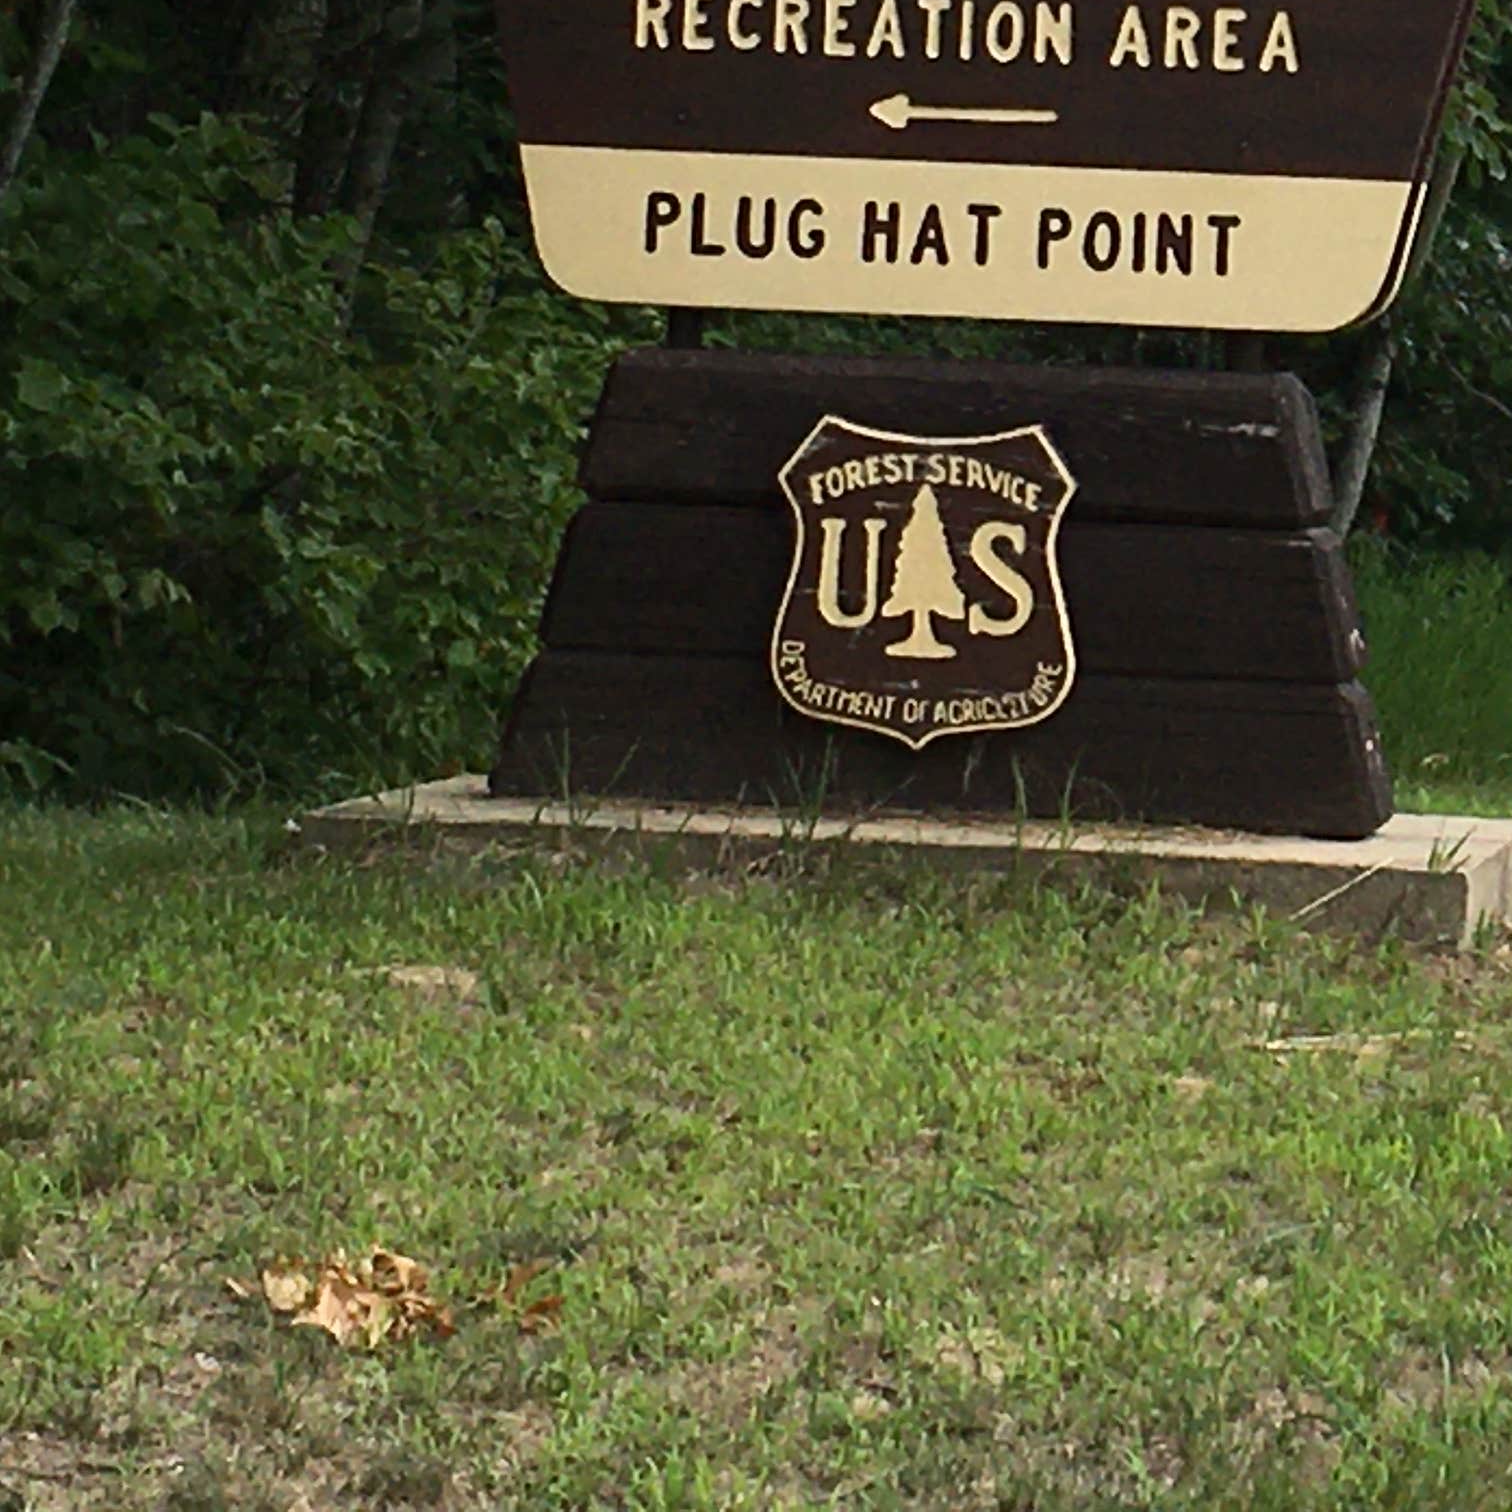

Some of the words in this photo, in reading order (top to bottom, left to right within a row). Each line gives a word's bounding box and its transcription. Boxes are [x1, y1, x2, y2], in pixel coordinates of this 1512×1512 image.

[1110, 6, 1298, 72] AREA
[645, 192, 824, 258] PLUG
[862, 201, 1002, 266] HAT
[1038, 208, 1241, 276] POINT
[808, 452, 919, 505] FOREST
[926, 453, 1042, 511] SERVICE
[781, 639, 896, 720] DEPARTMENT
